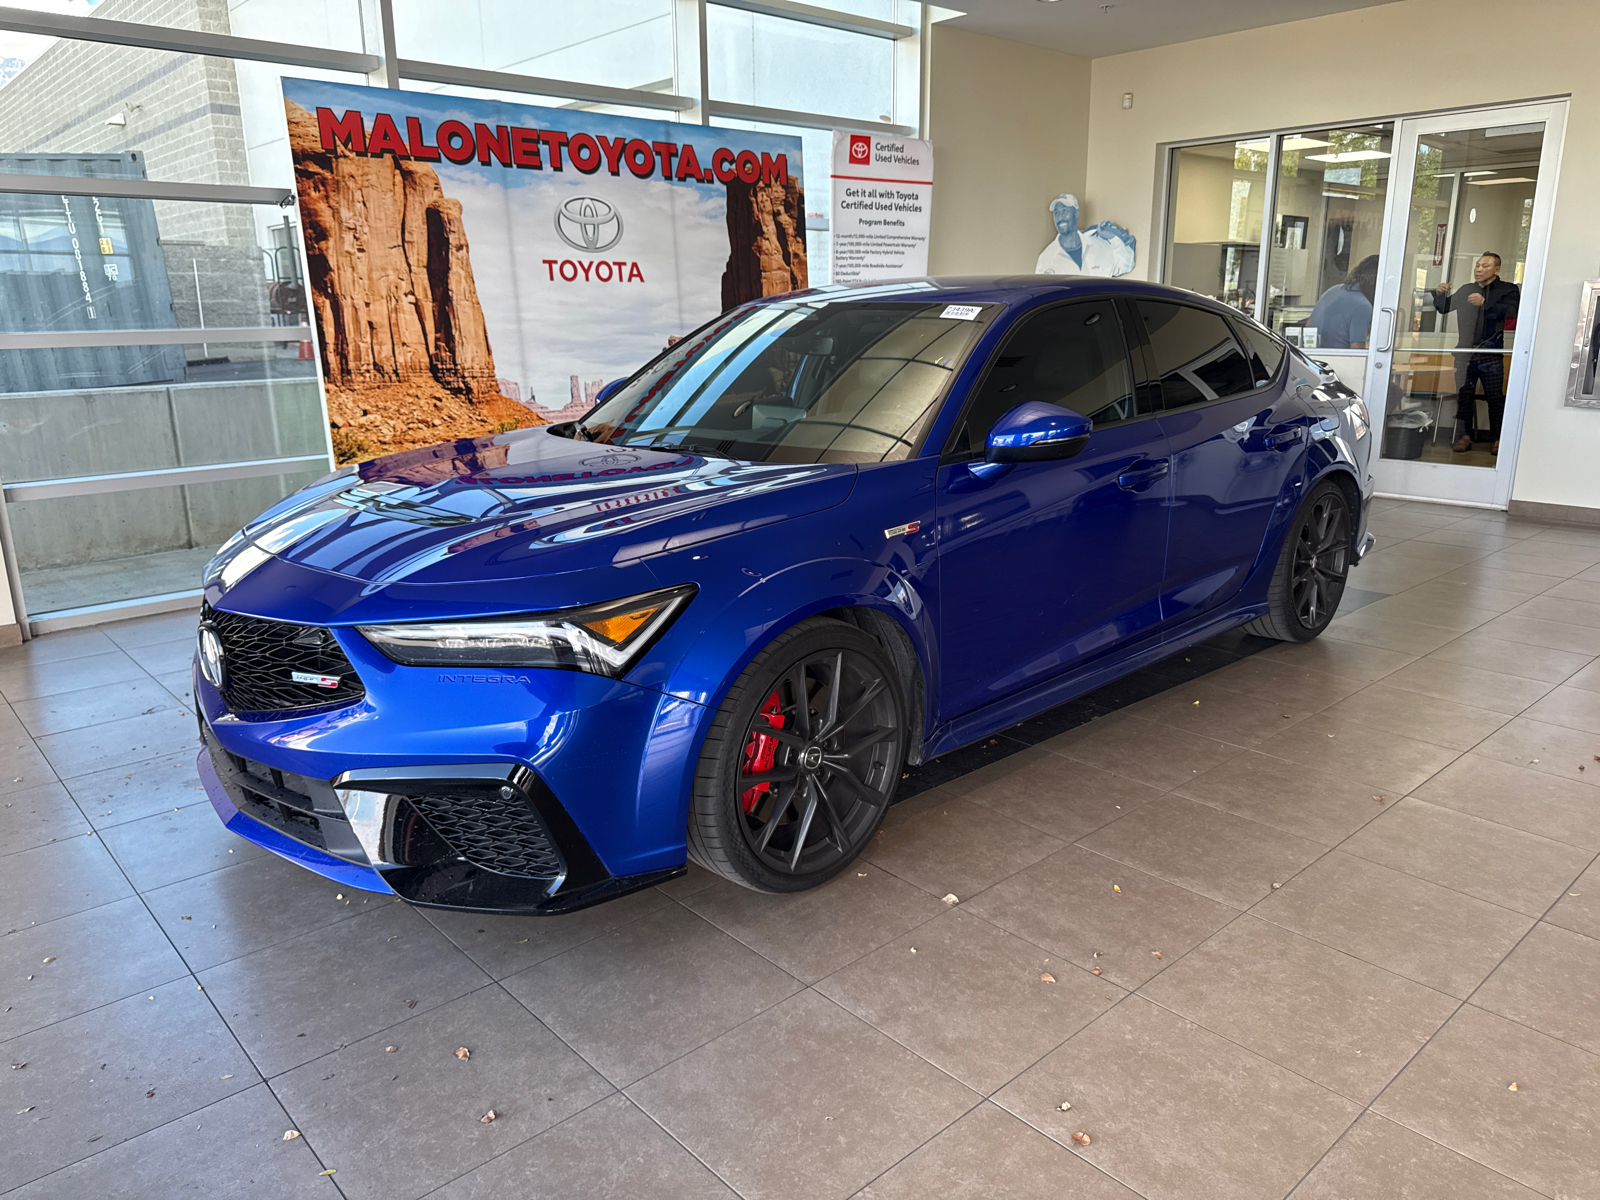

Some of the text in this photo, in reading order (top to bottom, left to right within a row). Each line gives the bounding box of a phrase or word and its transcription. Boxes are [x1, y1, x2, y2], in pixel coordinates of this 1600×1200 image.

[316, 107, 787, 186] MALONETOYOTA.COM
[875, 142, 904, 153] Certified
[875, 153, 920, 166] Used Vehicles
[845, 187, 919, 202] Get it all with Toyota
[840, 200, 922, 213] Certified Used Vehicles
[859, 218, 905, 227] Program Benefits
[542, 259, 645, 283] TOYOTA
[438, 674, 531, 684] INTEGRA
